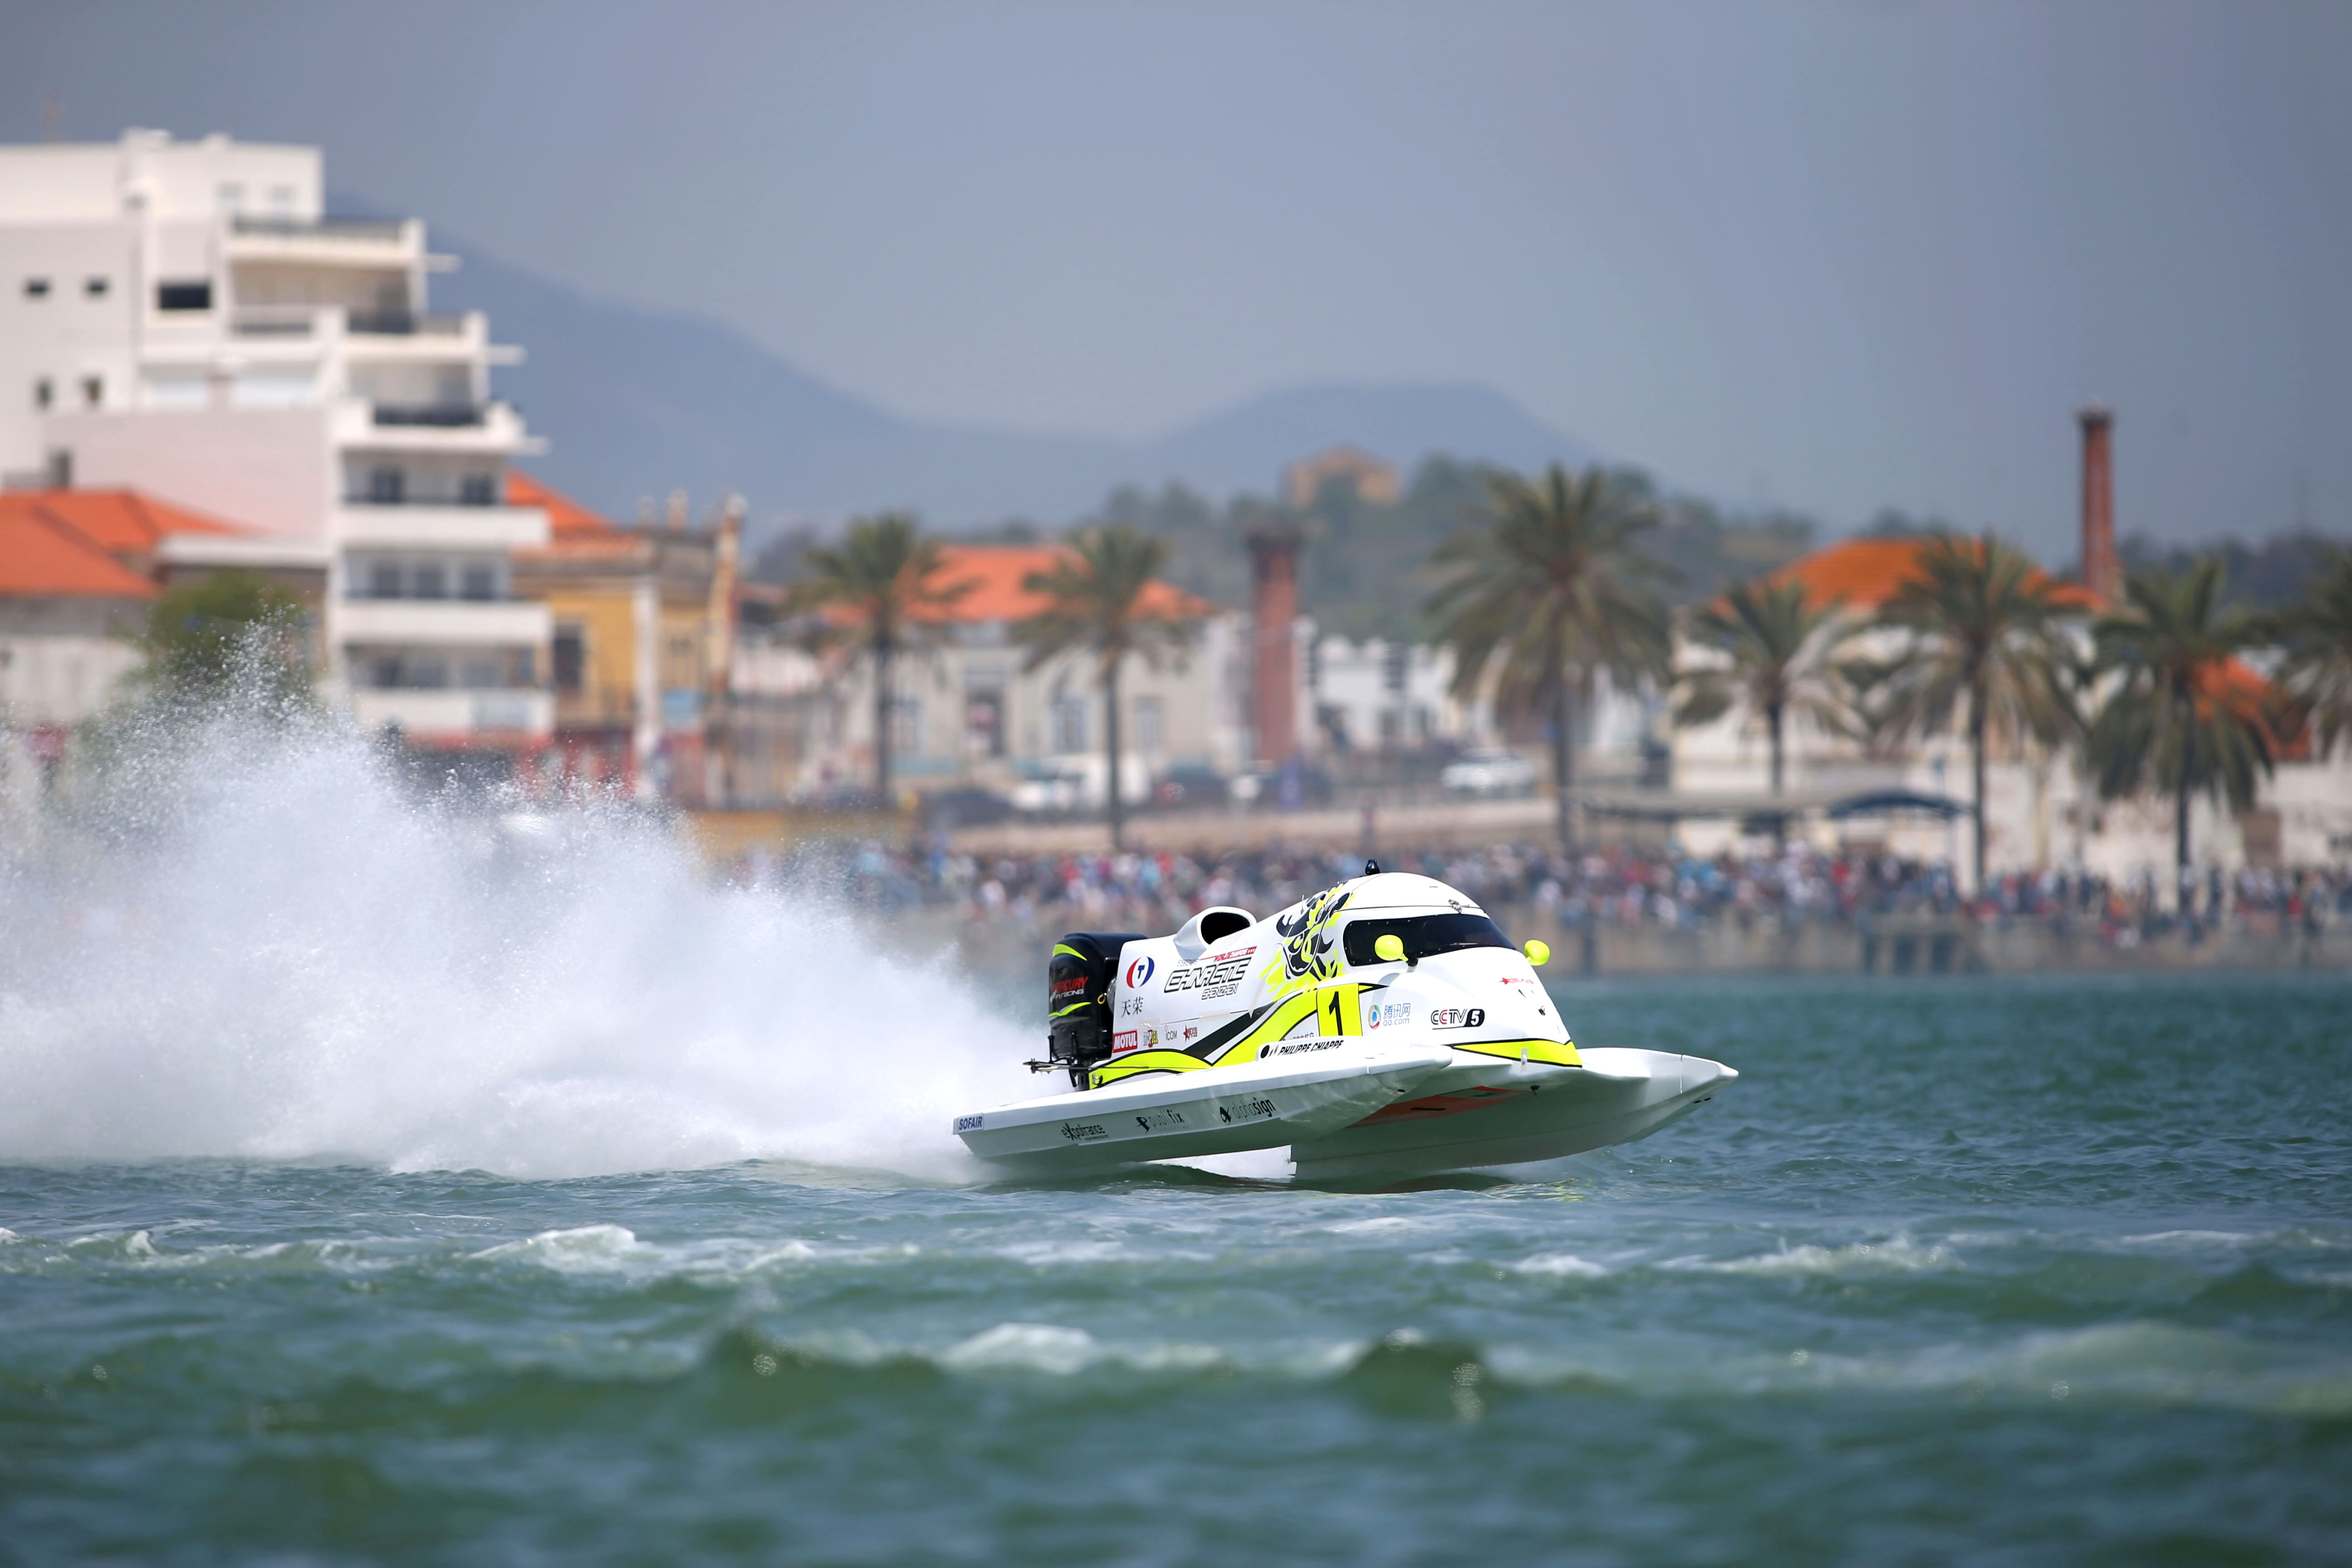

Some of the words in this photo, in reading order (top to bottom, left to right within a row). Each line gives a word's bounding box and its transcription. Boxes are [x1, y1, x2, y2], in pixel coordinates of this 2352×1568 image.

[1201, 983, 1239, 1000] SHENZHEN
[1121, 996, 1143, 1018] 天荣
[1328, 991, 1343, 1036] 1
[1383, 1003, 1411, 1019] 腾讯网
[1431, 1009, 1468, 1025] CCTV
[1470, 1010, 1480, 1026] 5
[1114, 1032, 1137, 1049] MOTUL
[1278, 1044, 1312, 1056] PHILIPPE
[1310, 1040, 1344, 1052] CHIAPPE
[1232, 1097, 1276, 1122] alphasign
[959, 1116, 982, 1130] SOFAIR
